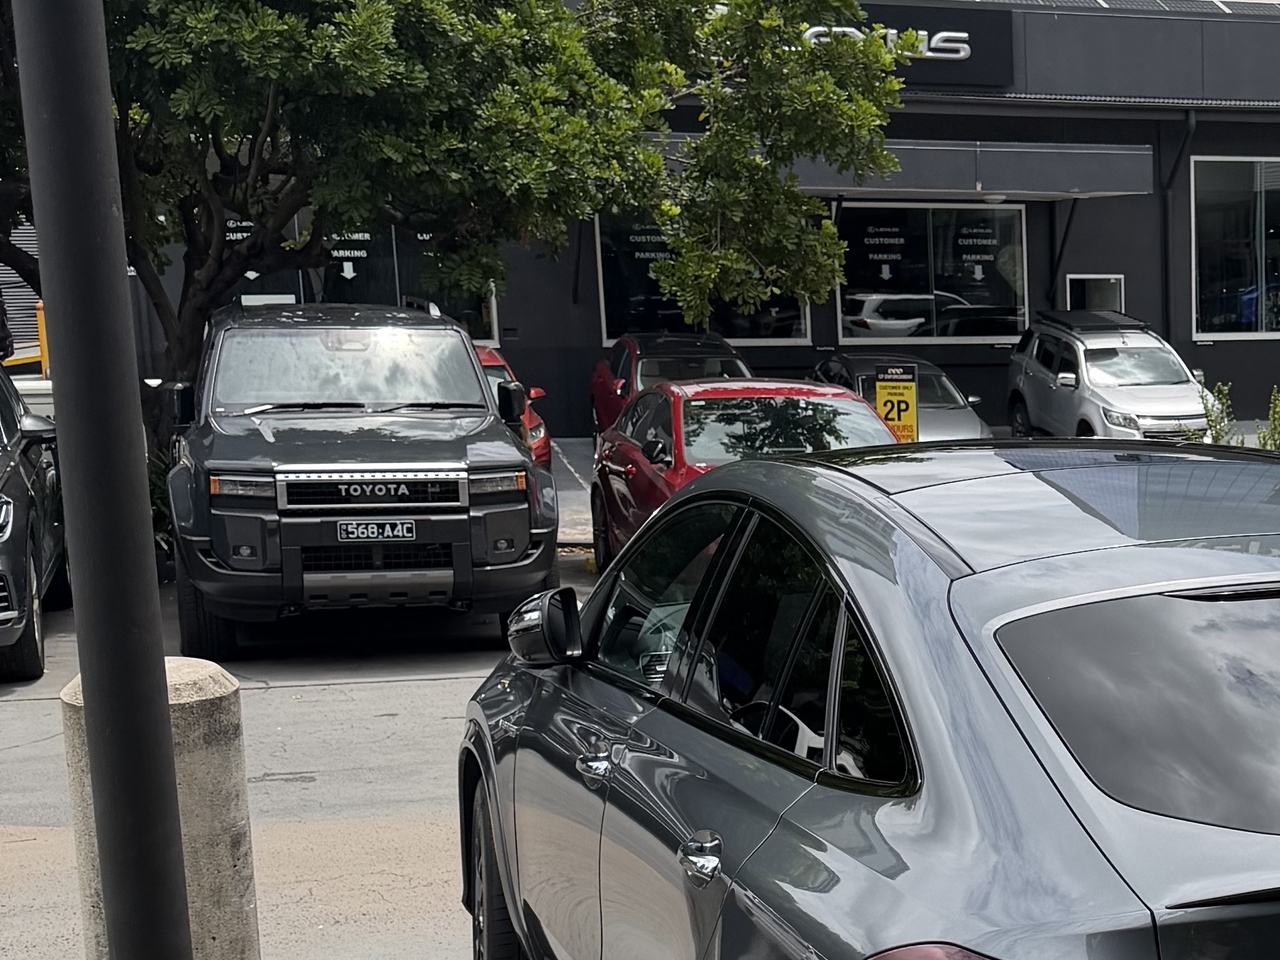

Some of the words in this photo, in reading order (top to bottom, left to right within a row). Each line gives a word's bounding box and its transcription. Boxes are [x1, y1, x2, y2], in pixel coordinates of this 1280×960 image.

[864, 237, 905, 245] CUSTOMER
[958, 238, 998, 246] CUSTOMER
[331, 250, 367, 258] ARKING
[883, 399, 910, 422] 2P
[891, 424, 914, 434] OURS
[338, 484, 410, 496] TOYOTA
